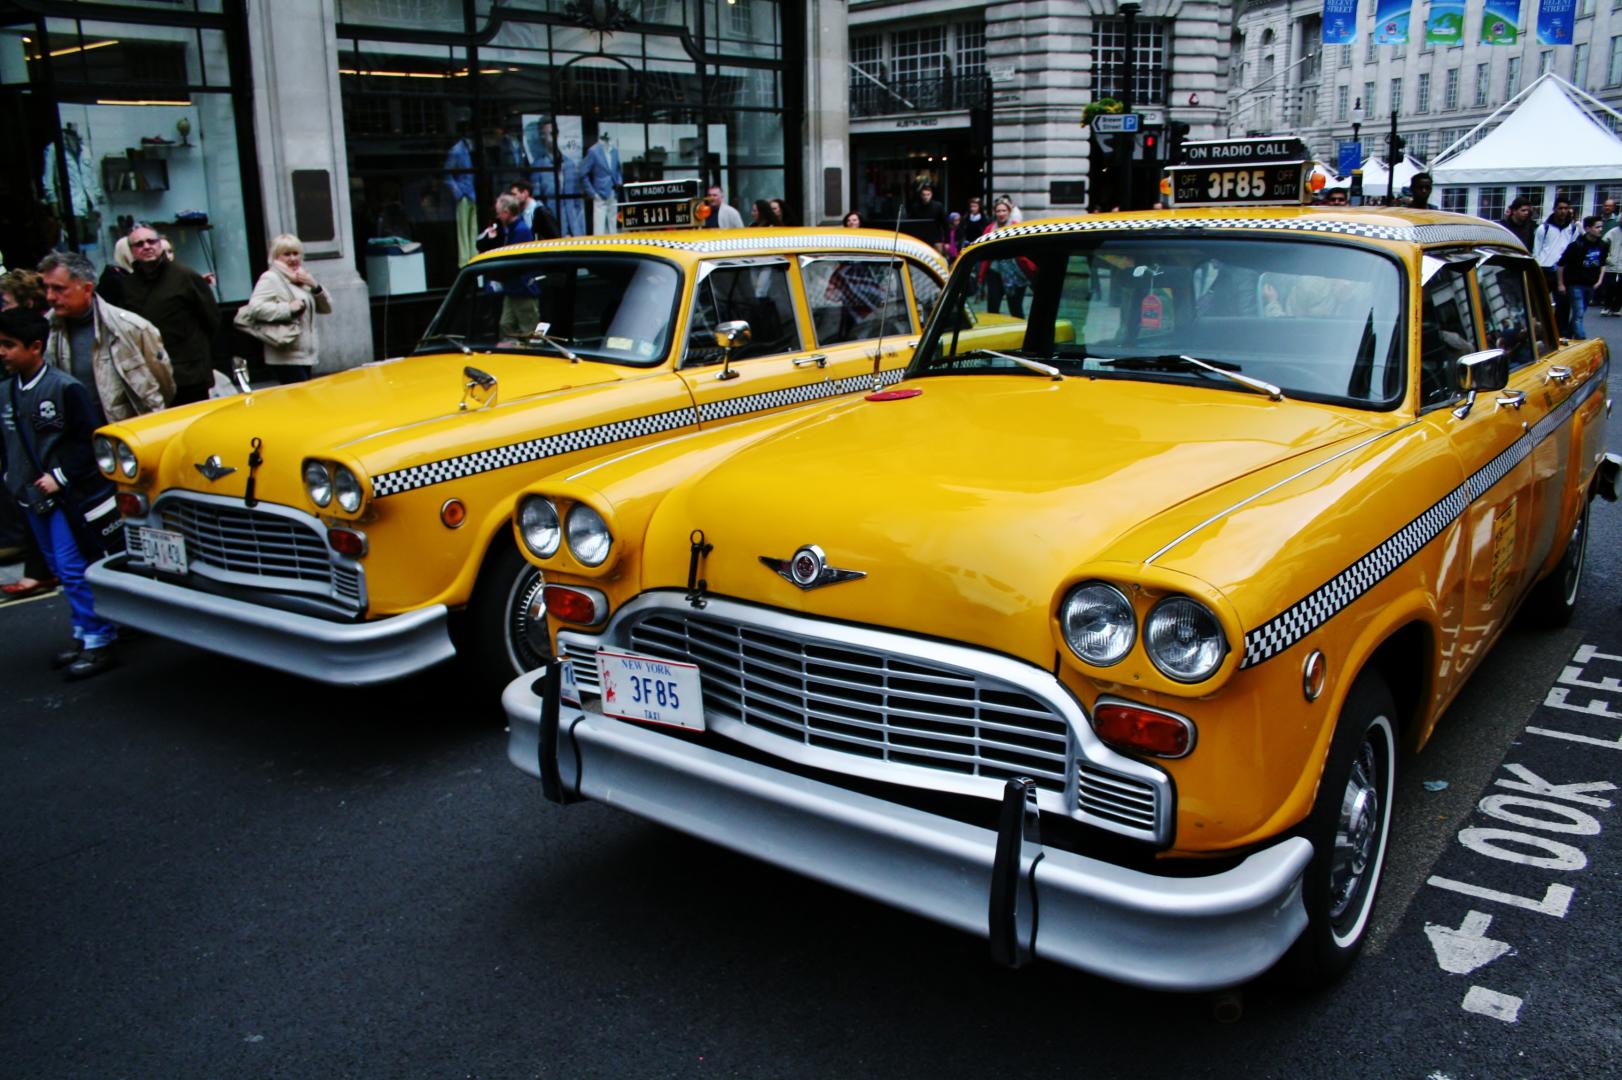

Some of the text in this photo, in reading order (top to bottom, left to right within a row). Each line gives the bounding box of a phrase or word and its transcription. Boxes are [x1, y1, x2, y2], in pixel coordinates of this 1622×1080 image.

[1190, 143, 1289, 159] ON RADIO CALL
[1181, 174, 1197, 185] OFF
[1277, 170, 1294, 181] OFF
[1208, 170, 1266, 199] 3F85
[1274, 184, 1297, 195] DUTY
[630, 185, 685, 196] ON RADIO CALL
[1178, 188, 1200, 199] DUTY
[675, 215, 689, 223] DUTY
[621, 659, 672, 676] NEW YORK
[630, 675, 680, 710] 3F85
[644, 709, 661, 721] TAXI
[1427, 644, 1622, 918] LOOK LEFT
